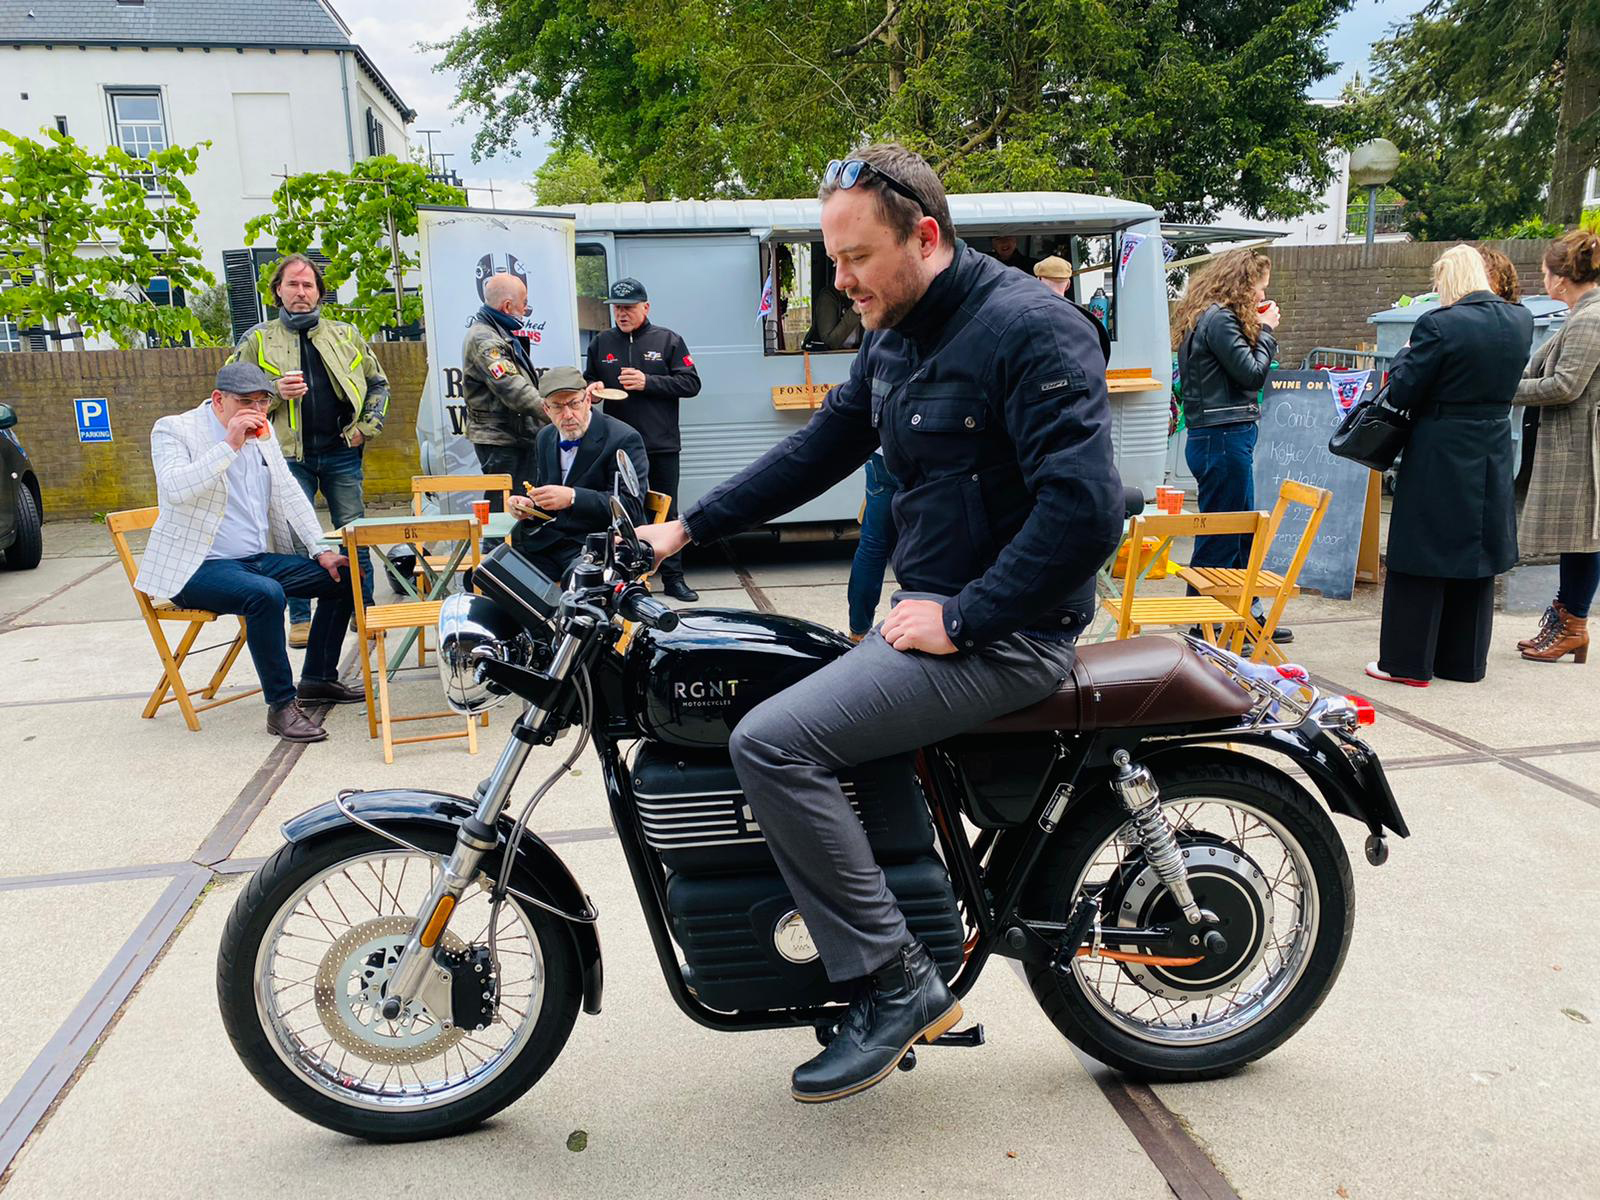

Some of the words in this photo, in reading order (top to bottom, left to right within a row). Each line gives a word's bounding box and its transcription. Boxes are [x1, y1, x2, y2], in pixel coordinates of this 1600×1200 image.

[1271, 380, 1301, 390] WINE
[1306, 380, 1323, 390] ON
[82, 402, 102, 426] P
[404, 527, 418, 539] BK
[674, 680, 739, 698] RGNT
